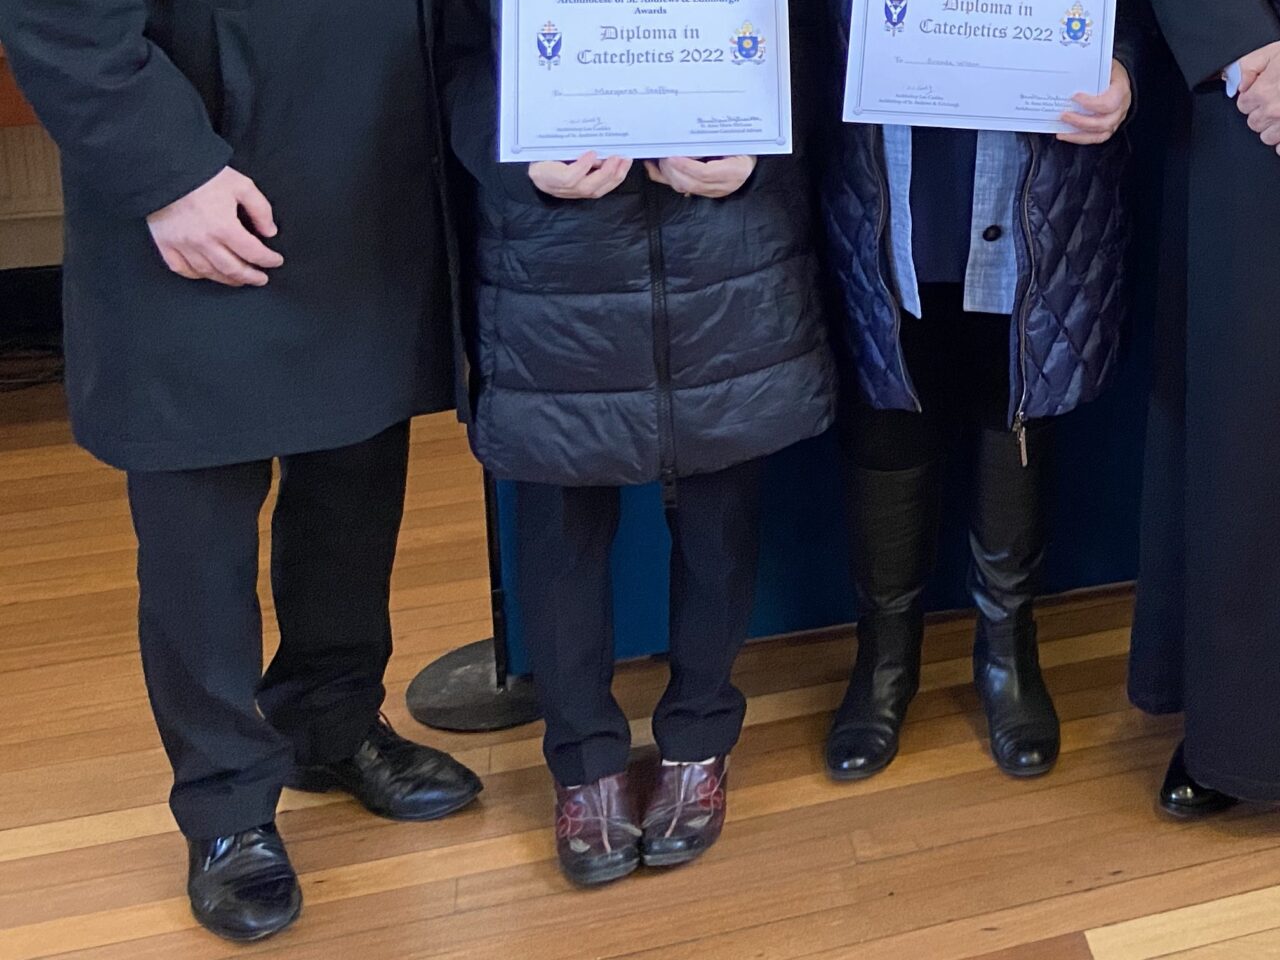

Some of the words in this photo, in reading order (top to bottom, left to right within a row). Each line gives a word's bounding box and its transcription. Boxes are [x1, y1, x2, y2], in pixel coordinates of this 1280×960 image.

[634, 7, 667, 15] Awards
[1018, 2, 1033, 17] in
[600, 26, 677, 42] Diploma
[684, 26, 700, 40] in
[919, 19, 1007, 39] Catechetics
[1012, 26, 1053, 42] 2022
[577, 49, 674, 66] Catechetics
[680, 48, 724, 63] 2022
